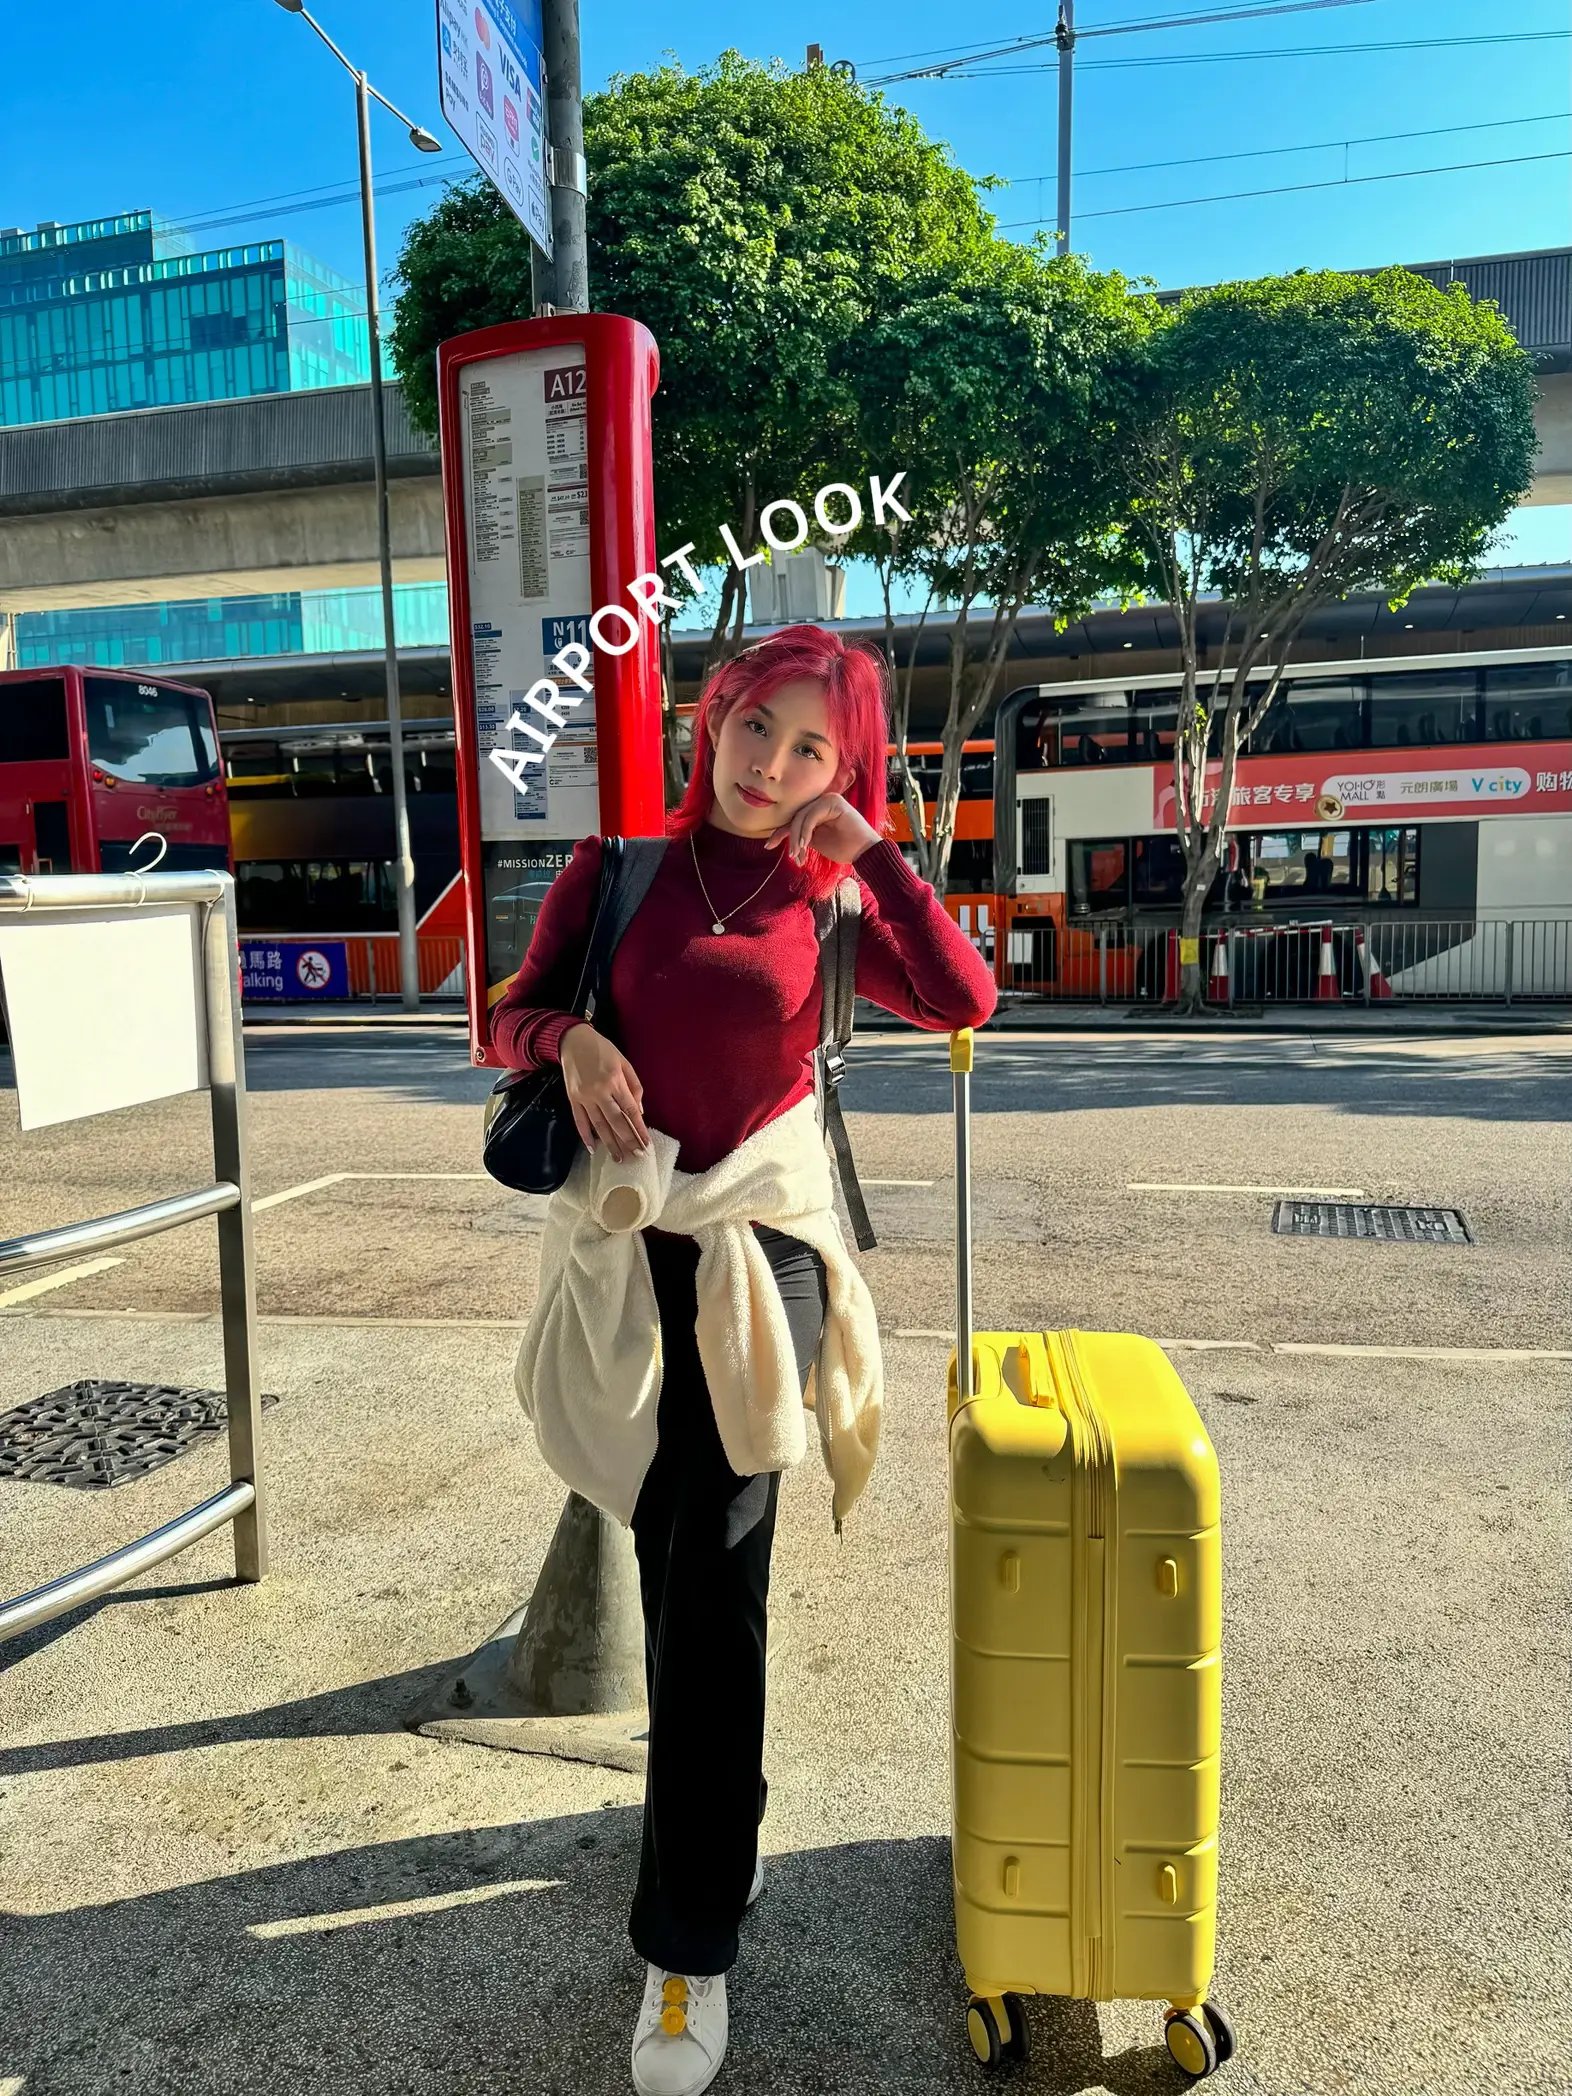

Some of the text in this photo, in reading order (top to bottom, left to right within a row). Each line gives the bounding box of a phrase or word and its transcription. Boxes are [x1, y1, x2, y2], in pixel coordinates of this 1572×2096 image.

[498, 42, 522, 102] VISA
[550, 370, 586, 398] A12
[138, 684, 158, 698] 8046
[1471, 775, 1522, 794] V city
[1340, 790, 1369, 801] MALL
[242, 972, 284, 992] alking
